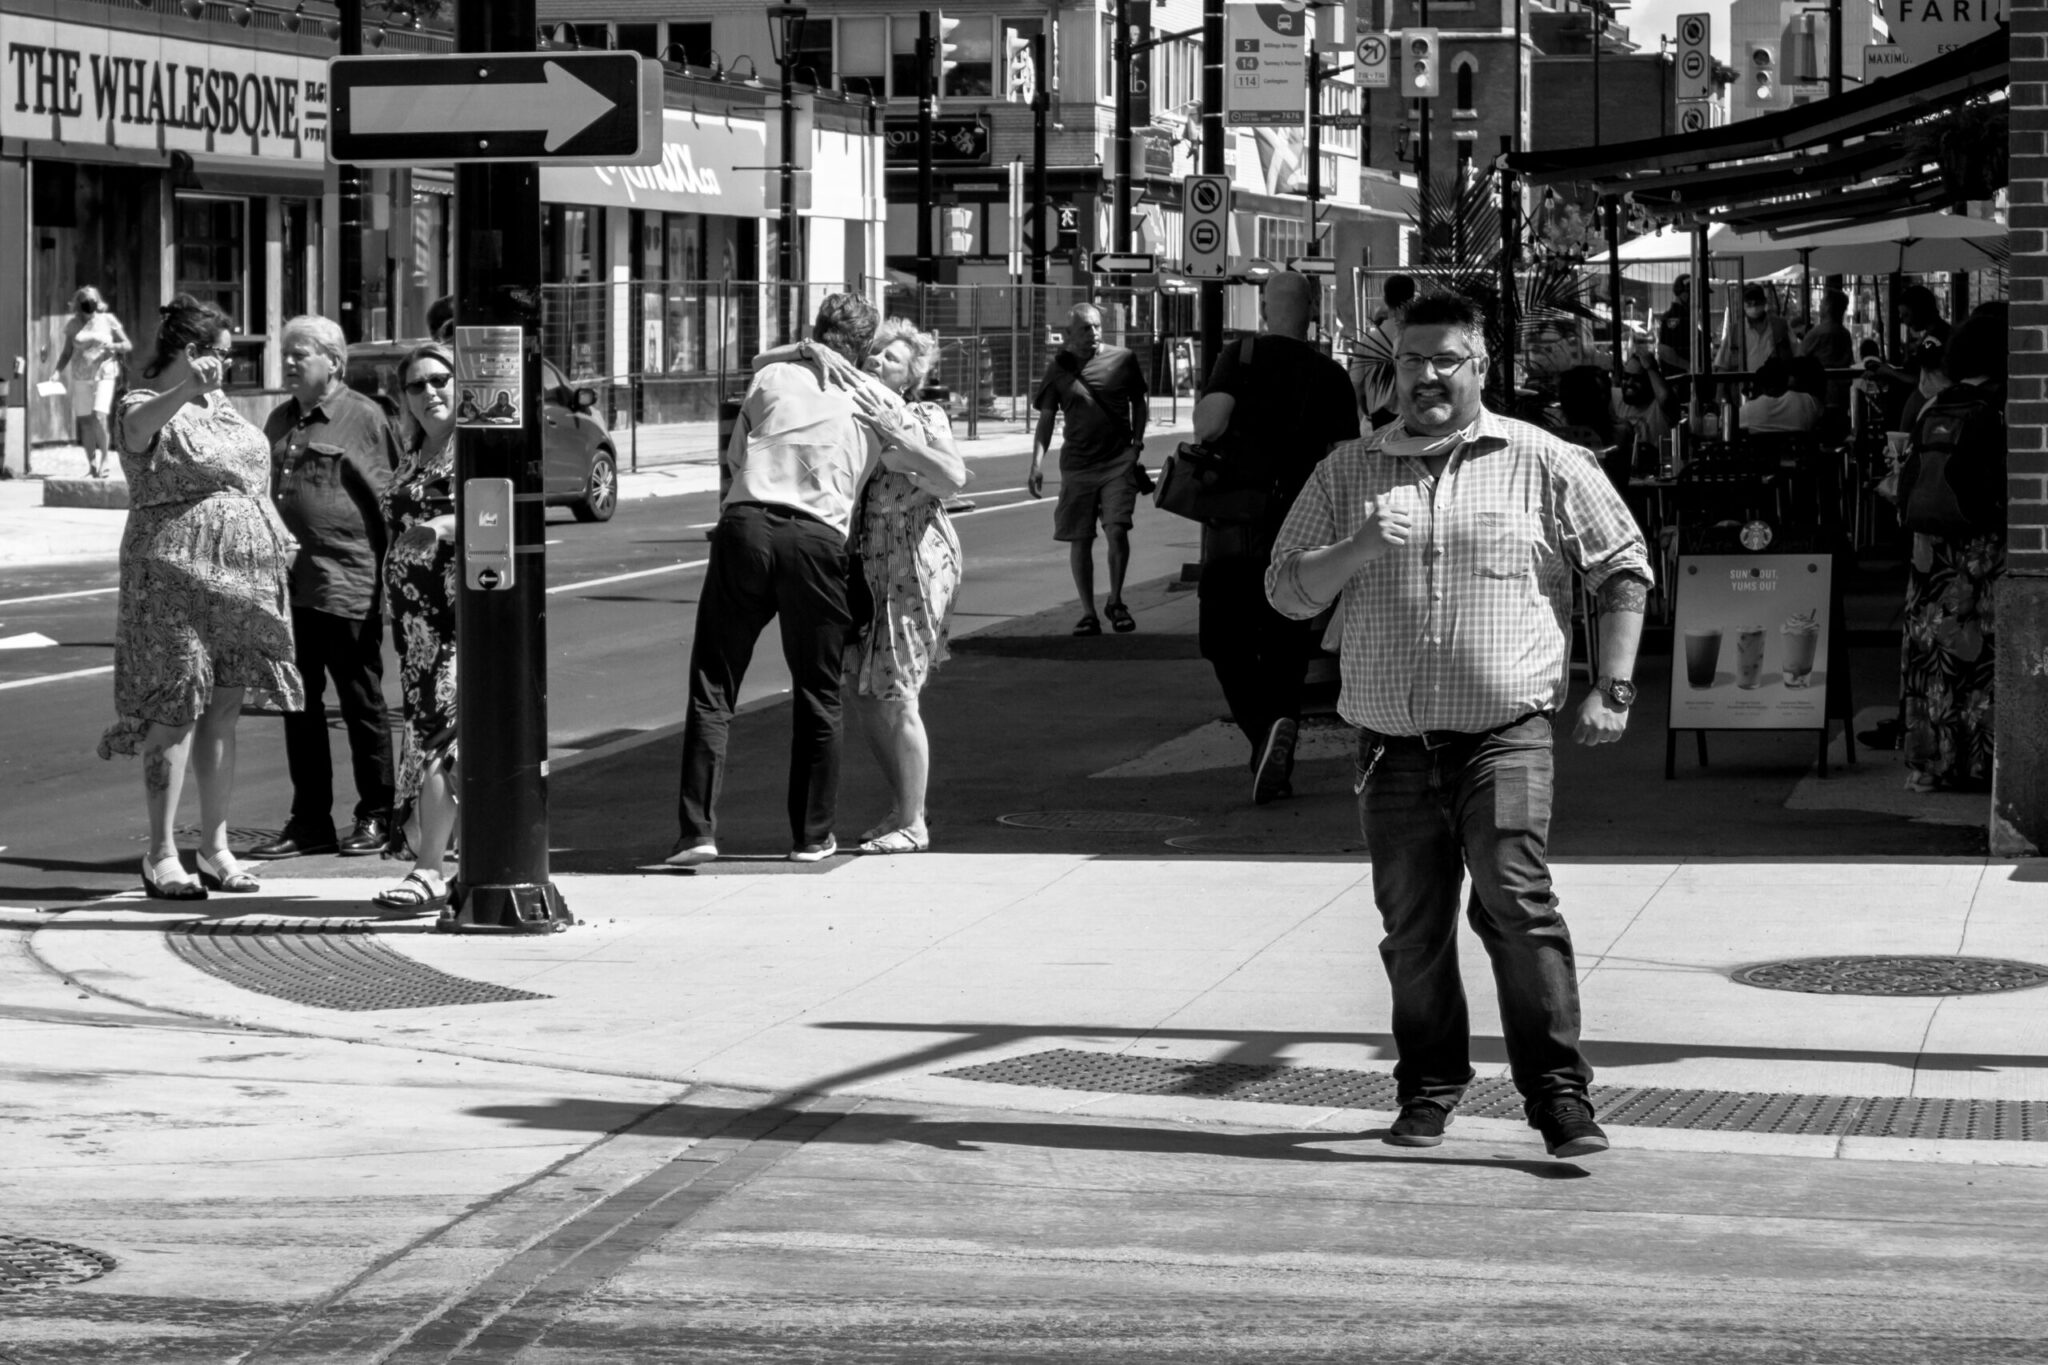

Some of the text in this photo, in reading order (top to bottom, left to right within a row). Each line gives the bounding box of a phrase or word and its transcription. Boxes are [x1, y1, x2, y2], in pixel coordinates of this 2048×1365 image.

[1243, 41, 1251, 51] 5
[1241, 58, 1254, 69] 14
[1238, 76, 1256, 86] 114
[8, 42, 299, 140] THE WHALESBONE
[1731, 581, 1776, 591] YUMS OUT
